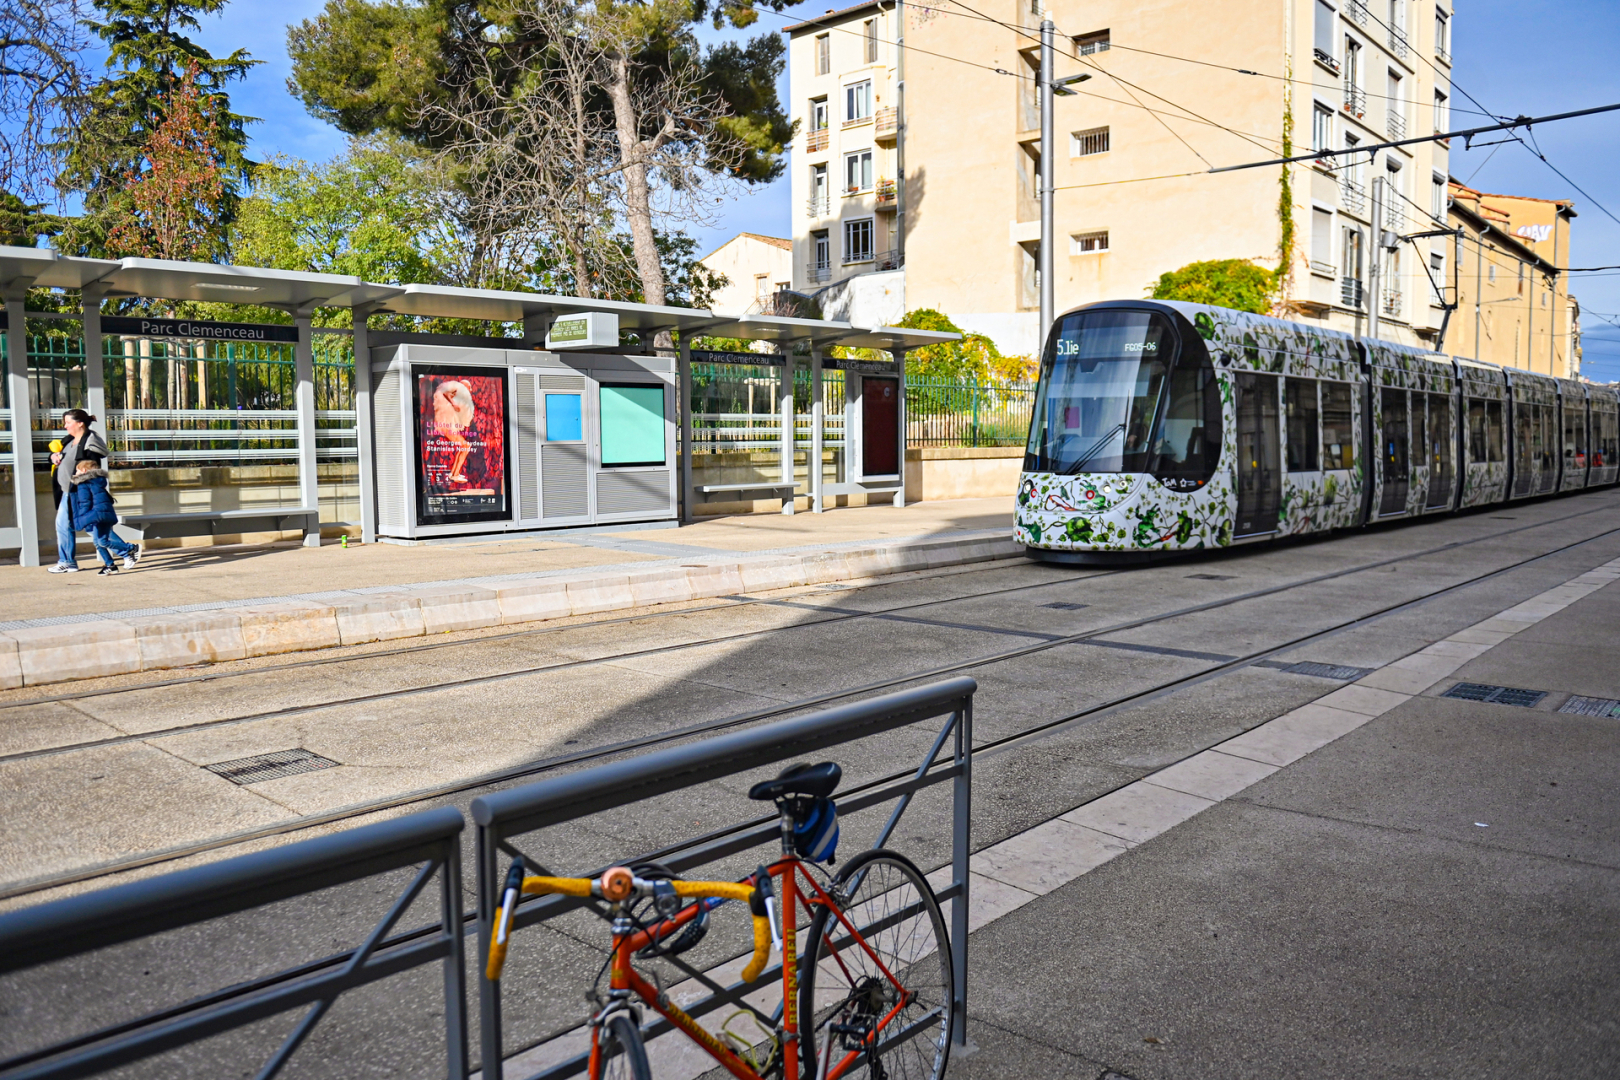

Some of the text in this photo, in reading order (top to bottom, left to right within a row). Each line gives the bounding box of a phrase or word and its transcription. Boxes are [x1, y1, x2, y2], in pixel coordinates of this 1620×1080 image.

[141, 321, 264, 339] Parc Clemenceau
[708, 352, 770, 365] Parc Clemenceau
[836, 361, 886, 371] Parc Clemenceau
[426, 421, 452, 429] L'Hôtel
